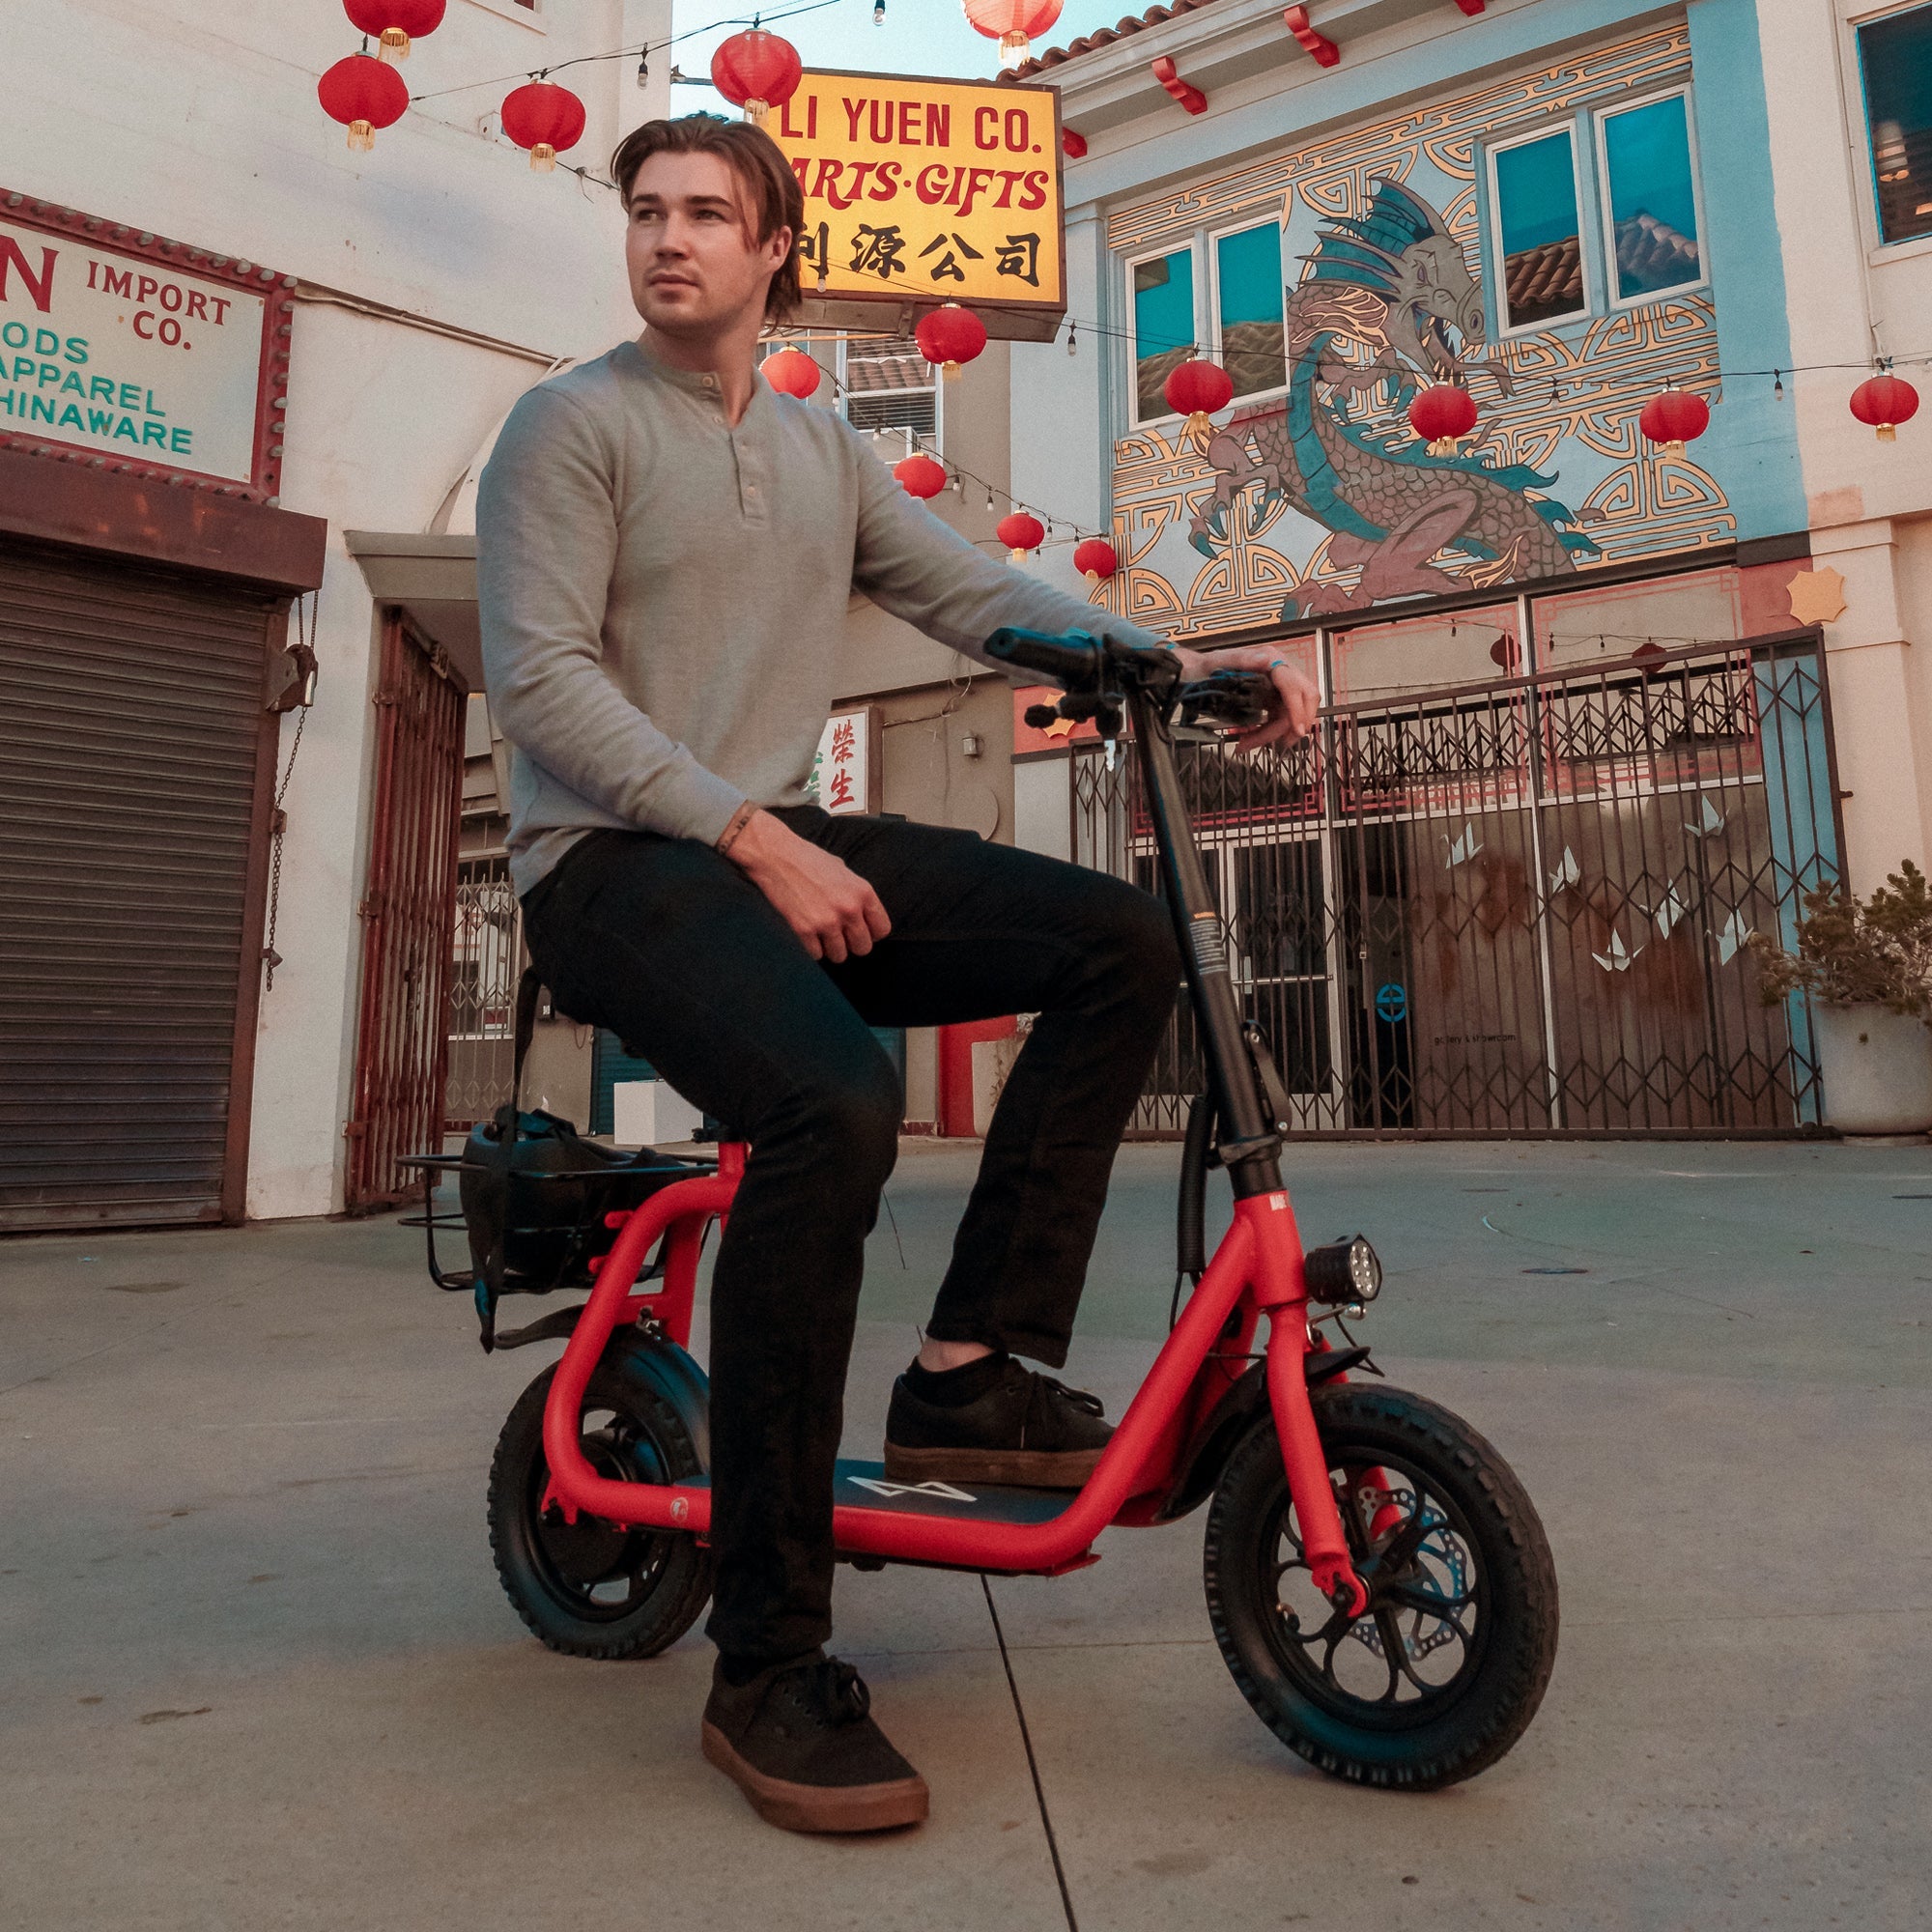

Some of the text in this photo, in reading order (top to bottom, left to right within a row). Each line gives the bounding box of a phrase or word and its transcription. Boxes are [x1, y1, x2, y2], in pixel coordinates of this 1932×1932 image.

[781, 95, 1042, 154] LI YUEN CO.
[86, 260, 231, 326] IMPORT
[132, 310, 191, 351] CO.
